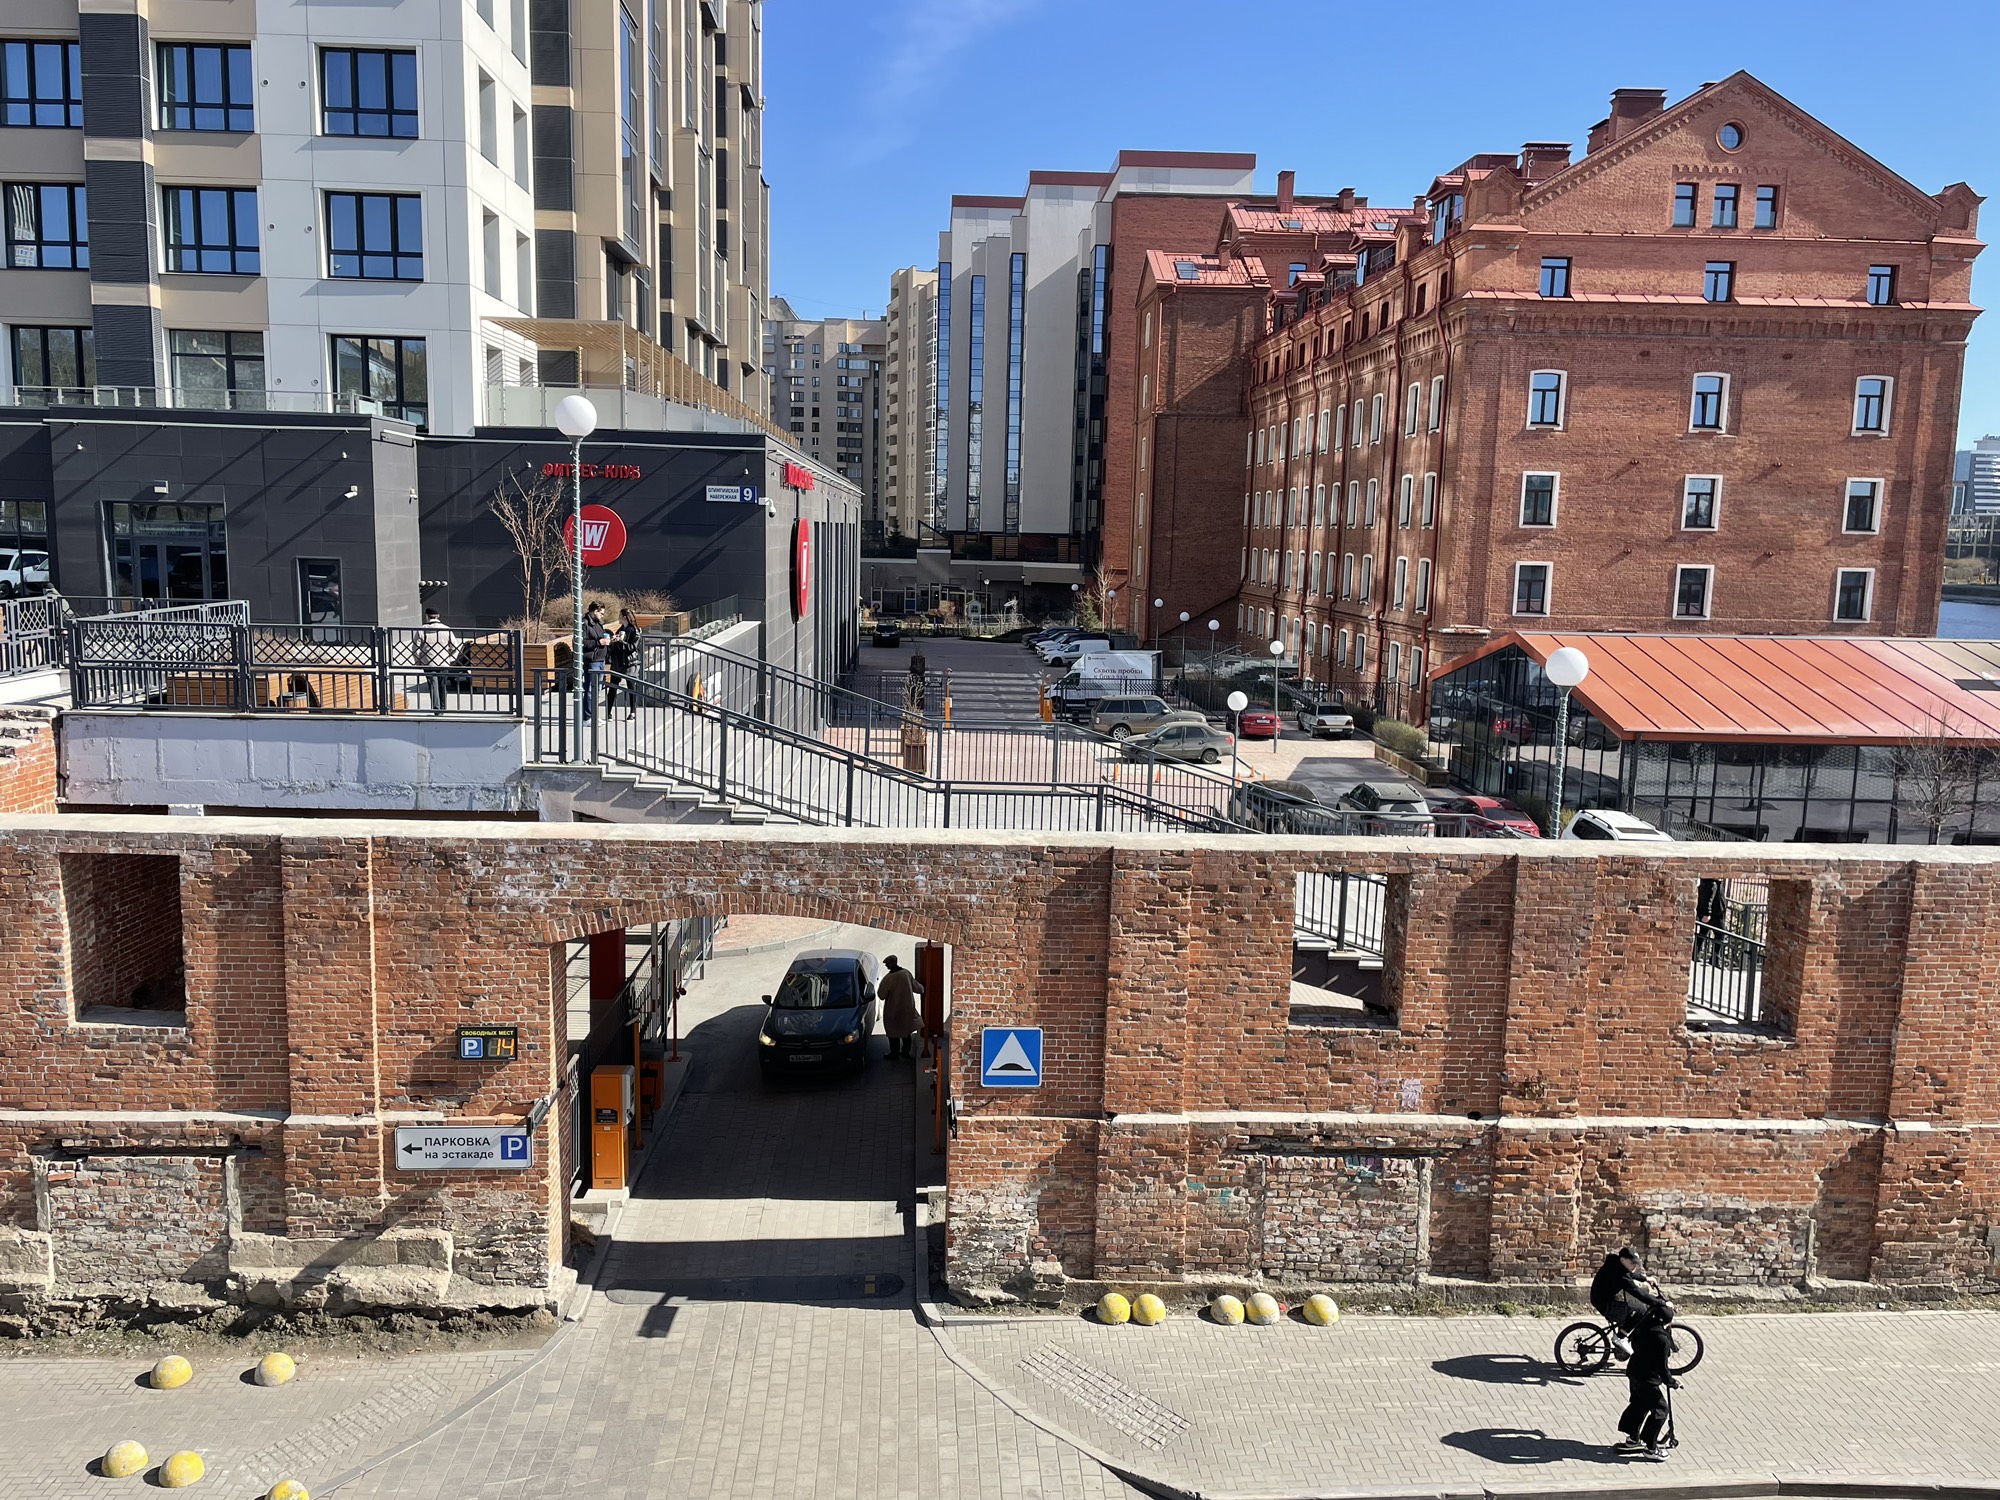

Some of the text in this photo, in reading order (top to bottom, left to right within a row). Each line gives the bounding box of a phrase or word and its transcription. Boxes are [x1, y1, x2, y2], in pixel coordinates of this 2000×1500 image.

[743, 487, 753, 501] 9
[585, 524, 605, 547] W
[1118, 667, 1143, 675] пробки
[496, 1038, 515, 1056] 14
[424, 1137, 491, 1146] ПАРКОВКА
[442, 1151, 494, 1160] эстакаде
